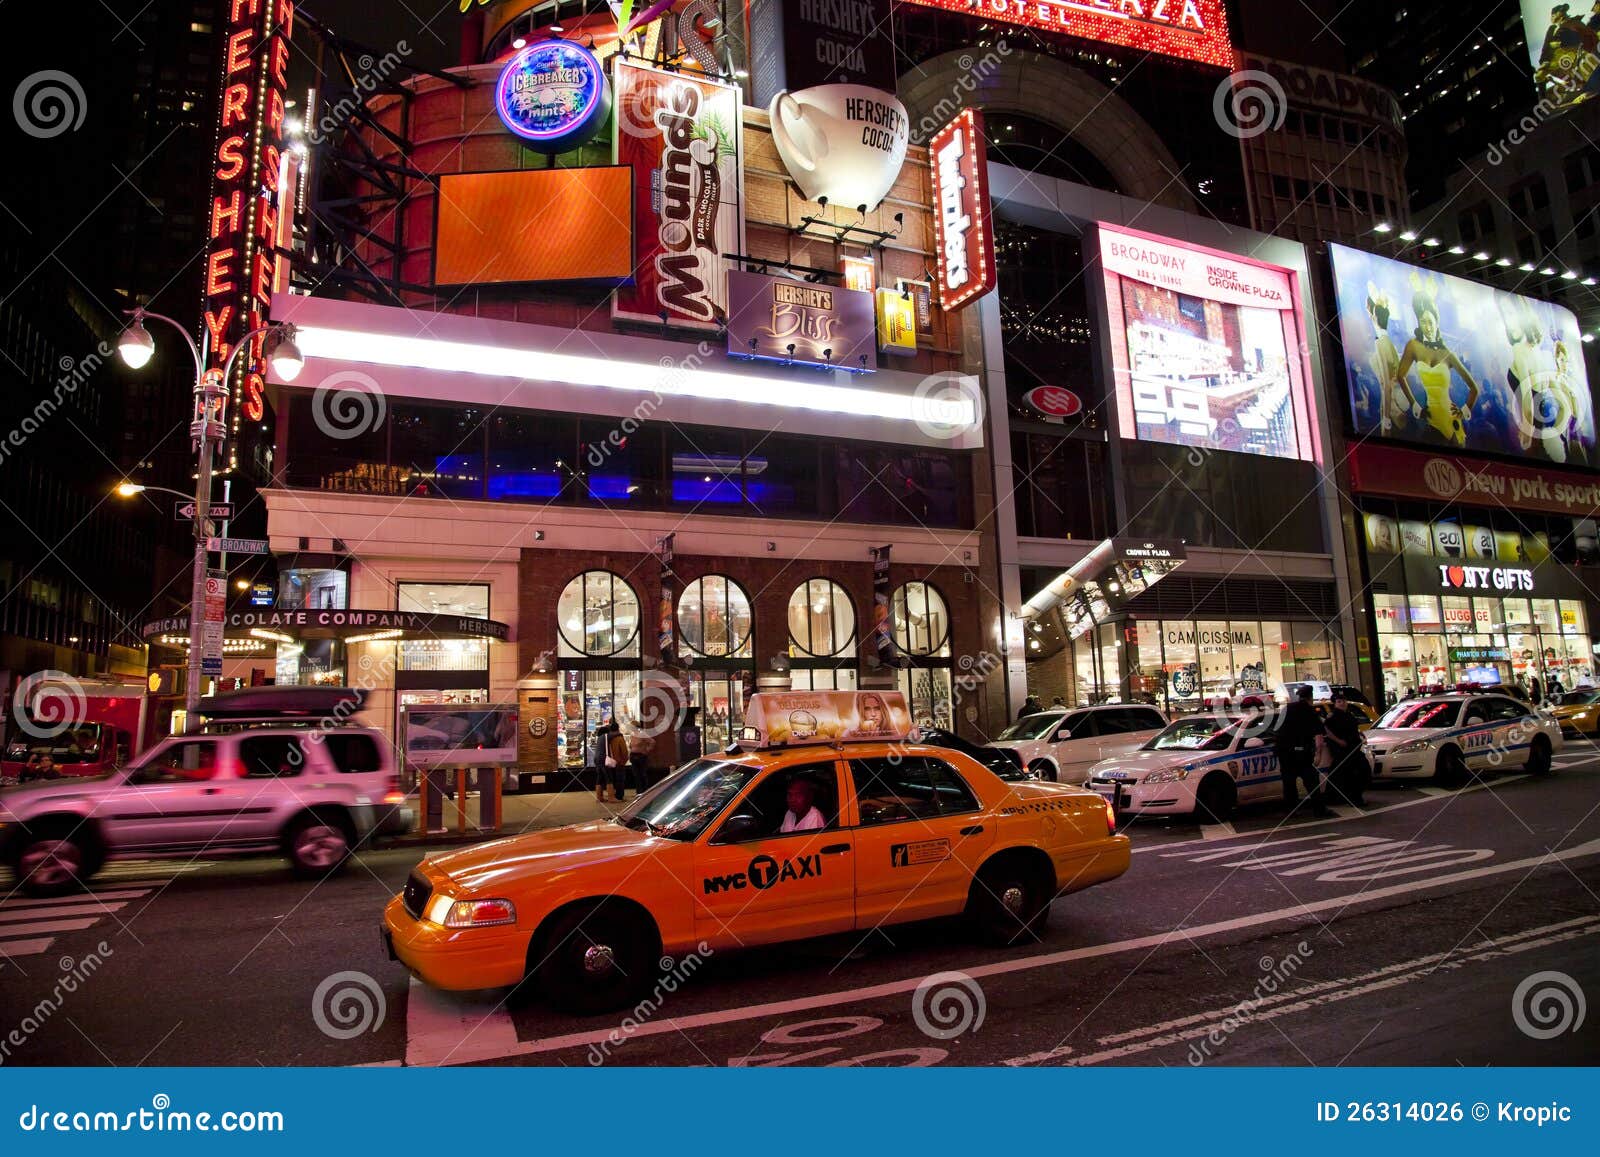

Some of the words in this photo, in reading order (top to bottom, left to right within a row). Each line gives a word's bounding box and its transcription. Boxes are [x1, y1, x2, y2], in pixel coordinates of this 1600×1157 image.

[970, 0, 1071, 26] OTEL
[816, 38, 866, 74] COCOA
[528, 105, 566, 119] mints
[846, 97, 906, 140] HERSHEY'S
[862, 126, 894, 153] COCOA
[656, 83, 714, 321] Mounds
[699, 168, 712, 214] CHOCOLATE
[697, 217, 706, 240] DARK
[1111, 242, 1187, 271] BROADWAY
[1206, 265, 1238, 282] INSIDE
[775, 283, 832, 310] HERSHEY'S
[1208, 276, 1252, 296] CROWNE
[1252, 287, 1283, 302] PLAZA
[766, 303, 839, 342] Bliss
[1465, 471, 1505, 495] new
[1509, 475, 1551, 502] york
[209, 507, 226, 515] WAY
[222, 540, 267, 553] BROADWAY
[1151, 549, 1171, 557] PLAZA
[1439, 565, 1450, 587] I
[1463, 568, 1490, 589] NY
[1492, 568, 1534, 591] GIFTS
[318, 612, 417, 627] COMPANY
[1168, 631, 1253, 645] CAMICISSIMA
[1468, 731, 1493, 748] NYPD
[1102, 771, 1128, 779] POLICE
[1241, 754, 1280, 777] NYPD
[703, 872, 748, 895] NYC
[752, 853, 823, 888] TAXI
